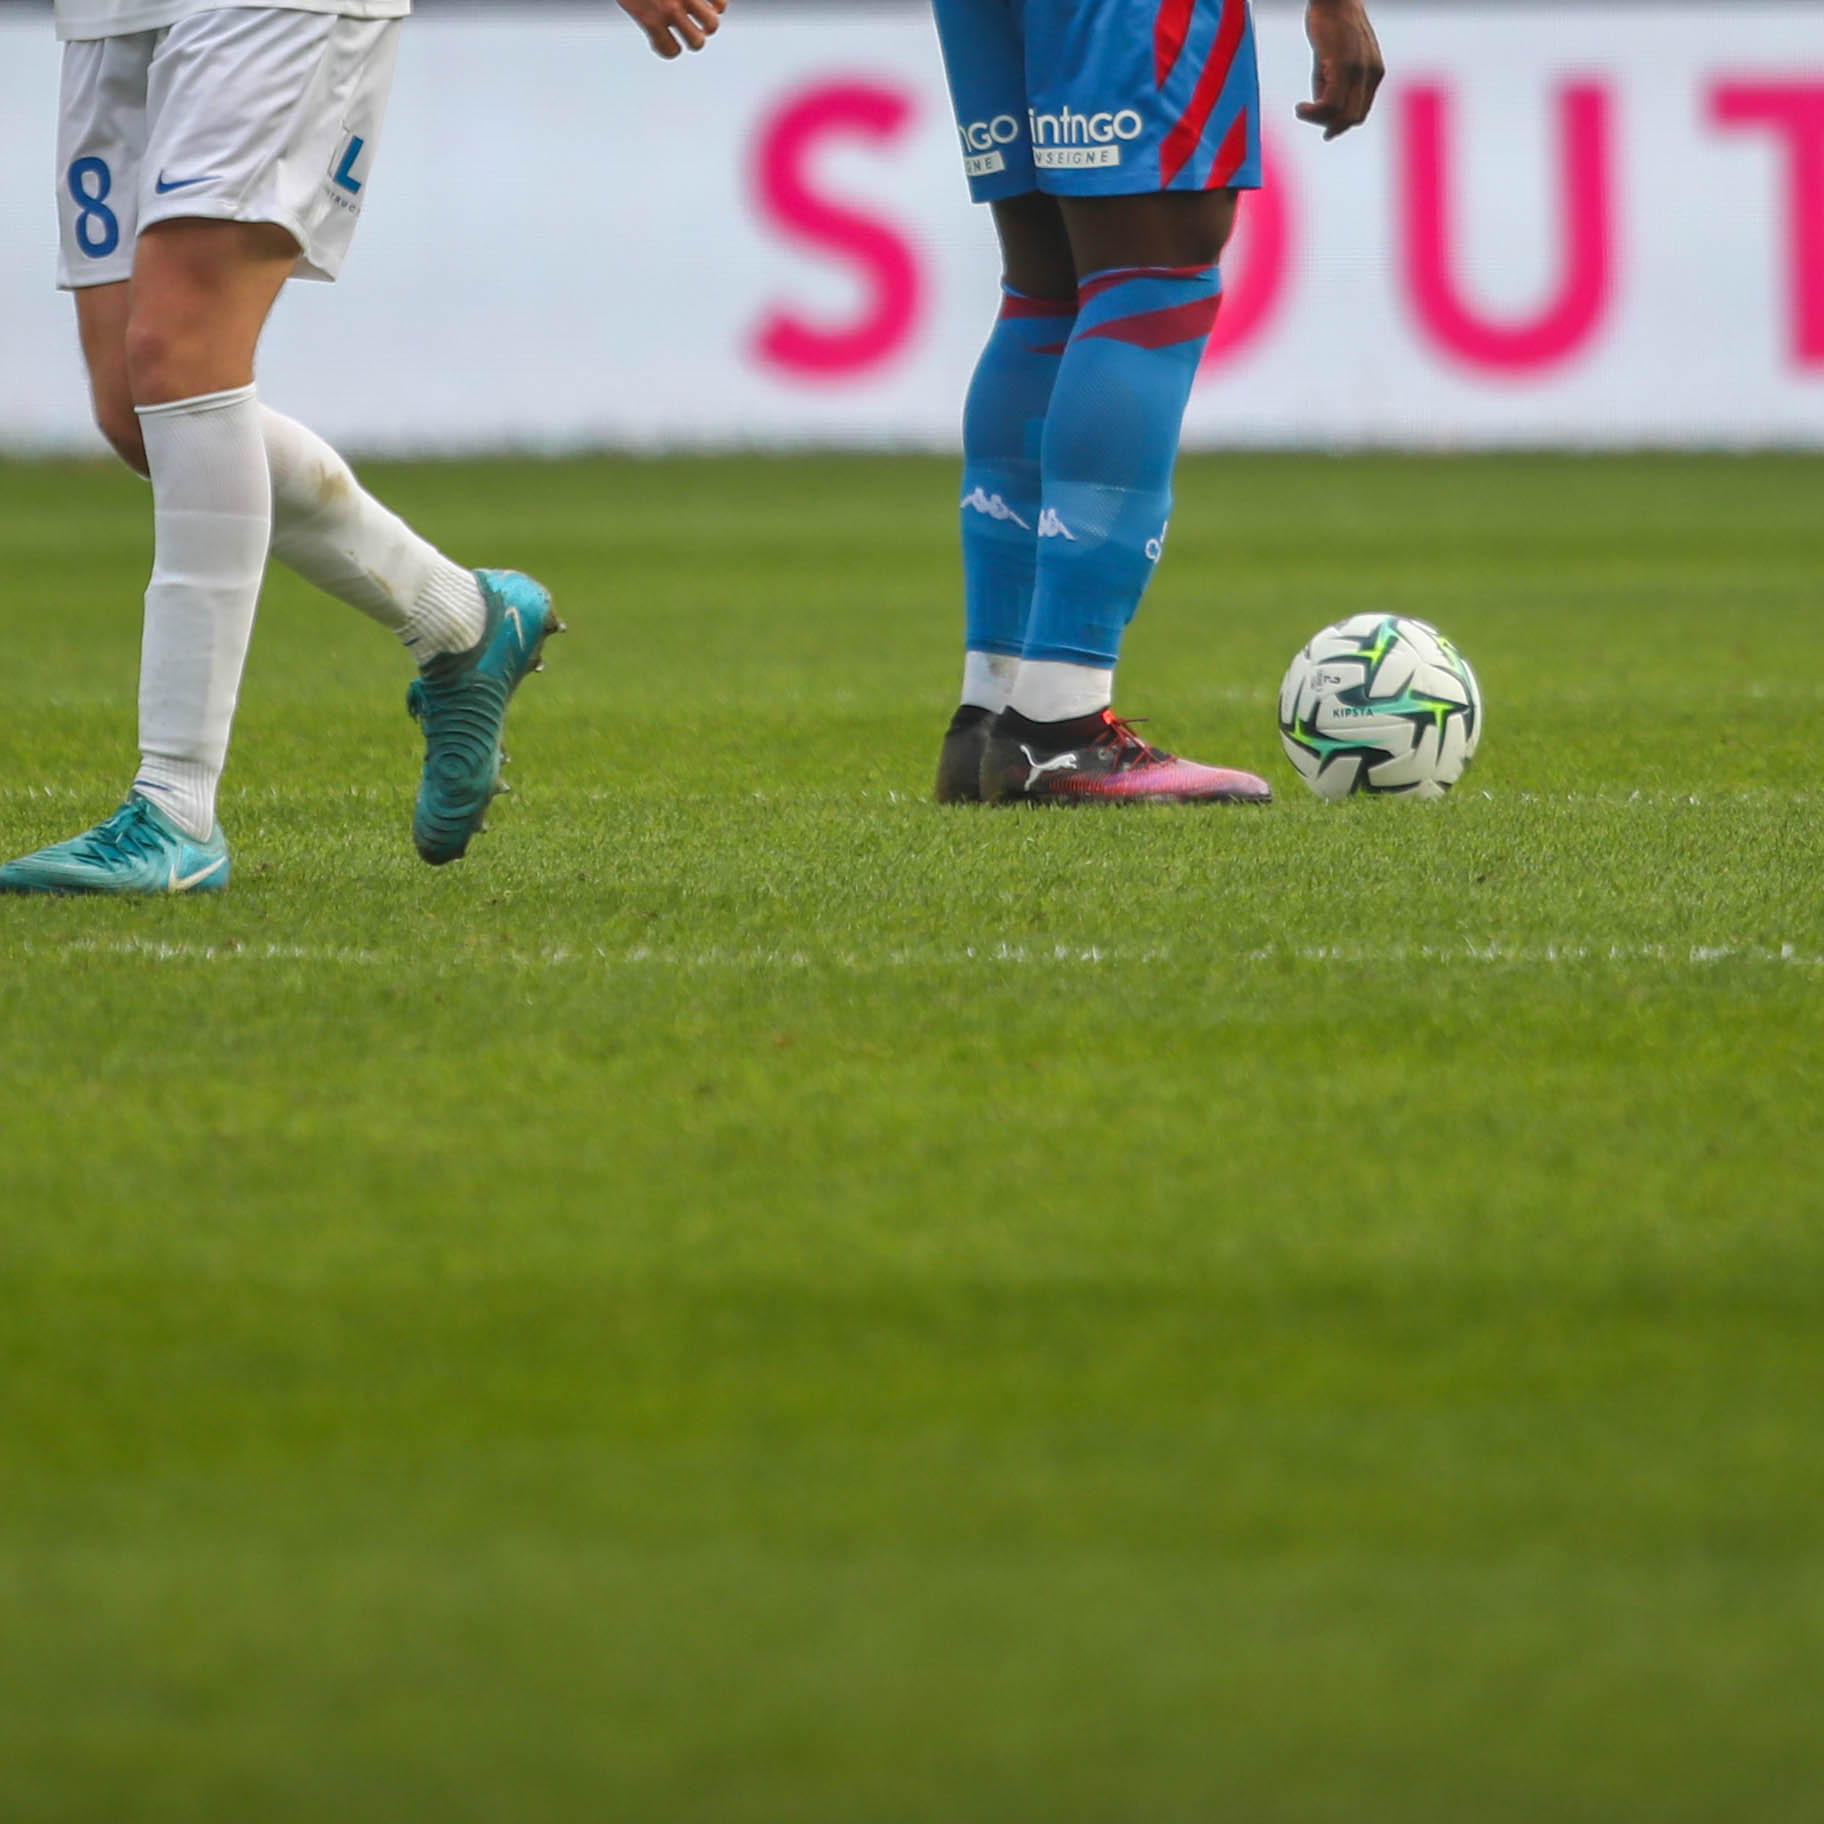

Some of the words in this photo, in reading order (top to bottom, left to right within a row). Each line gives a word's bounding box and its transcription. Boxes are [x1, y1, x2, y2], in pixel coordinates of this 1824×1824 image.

[1033, 149, 1109, 166] NSEIGNE
[67, 156, 119, 259] 8
[1332, 708, 1374, 719] KIPSTA
